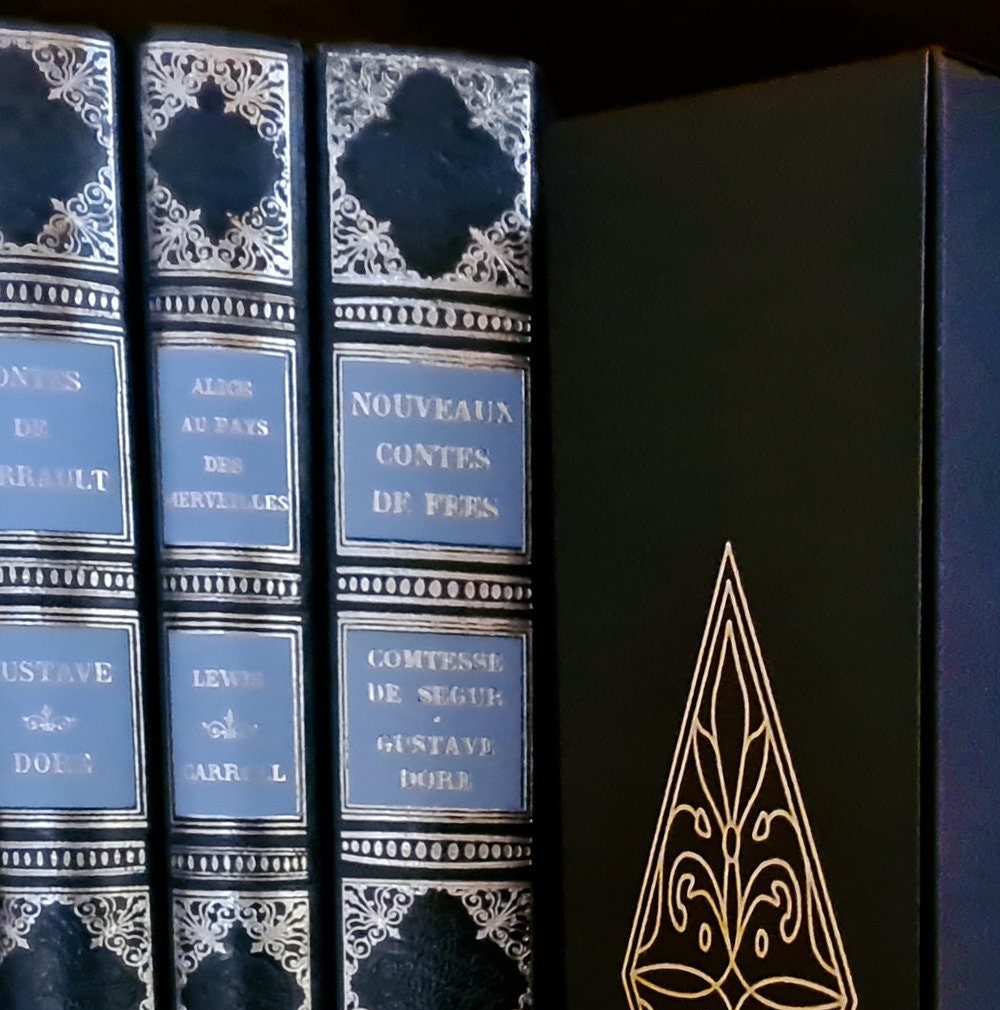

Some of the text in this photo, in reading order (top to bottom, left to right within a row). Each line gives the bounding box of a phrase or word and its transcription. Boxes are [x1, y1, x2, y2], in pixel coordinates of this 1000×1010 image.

[192, 377, 253, 397] ALICE
[352, 391, 513, 424] NOUVEAUX
[14, 417, 48, 438] DE
[181, 416, 270, 437] AU PAYS
[203, 455, 243, 475] DES
[375, 442, 492, 470] CONTES
[165, 490, 290, 512] MERVELES
[372, 490, 499, 518] DE FEES
[368, 649, 504, 672] COMTESSE
[192, 668, 265, 689] LEW
[368, 682, 504, 707] DE SEGUR
[376, 734, 496, 757] GUSTAVE
[183, 762, 287, 783] CARRL
